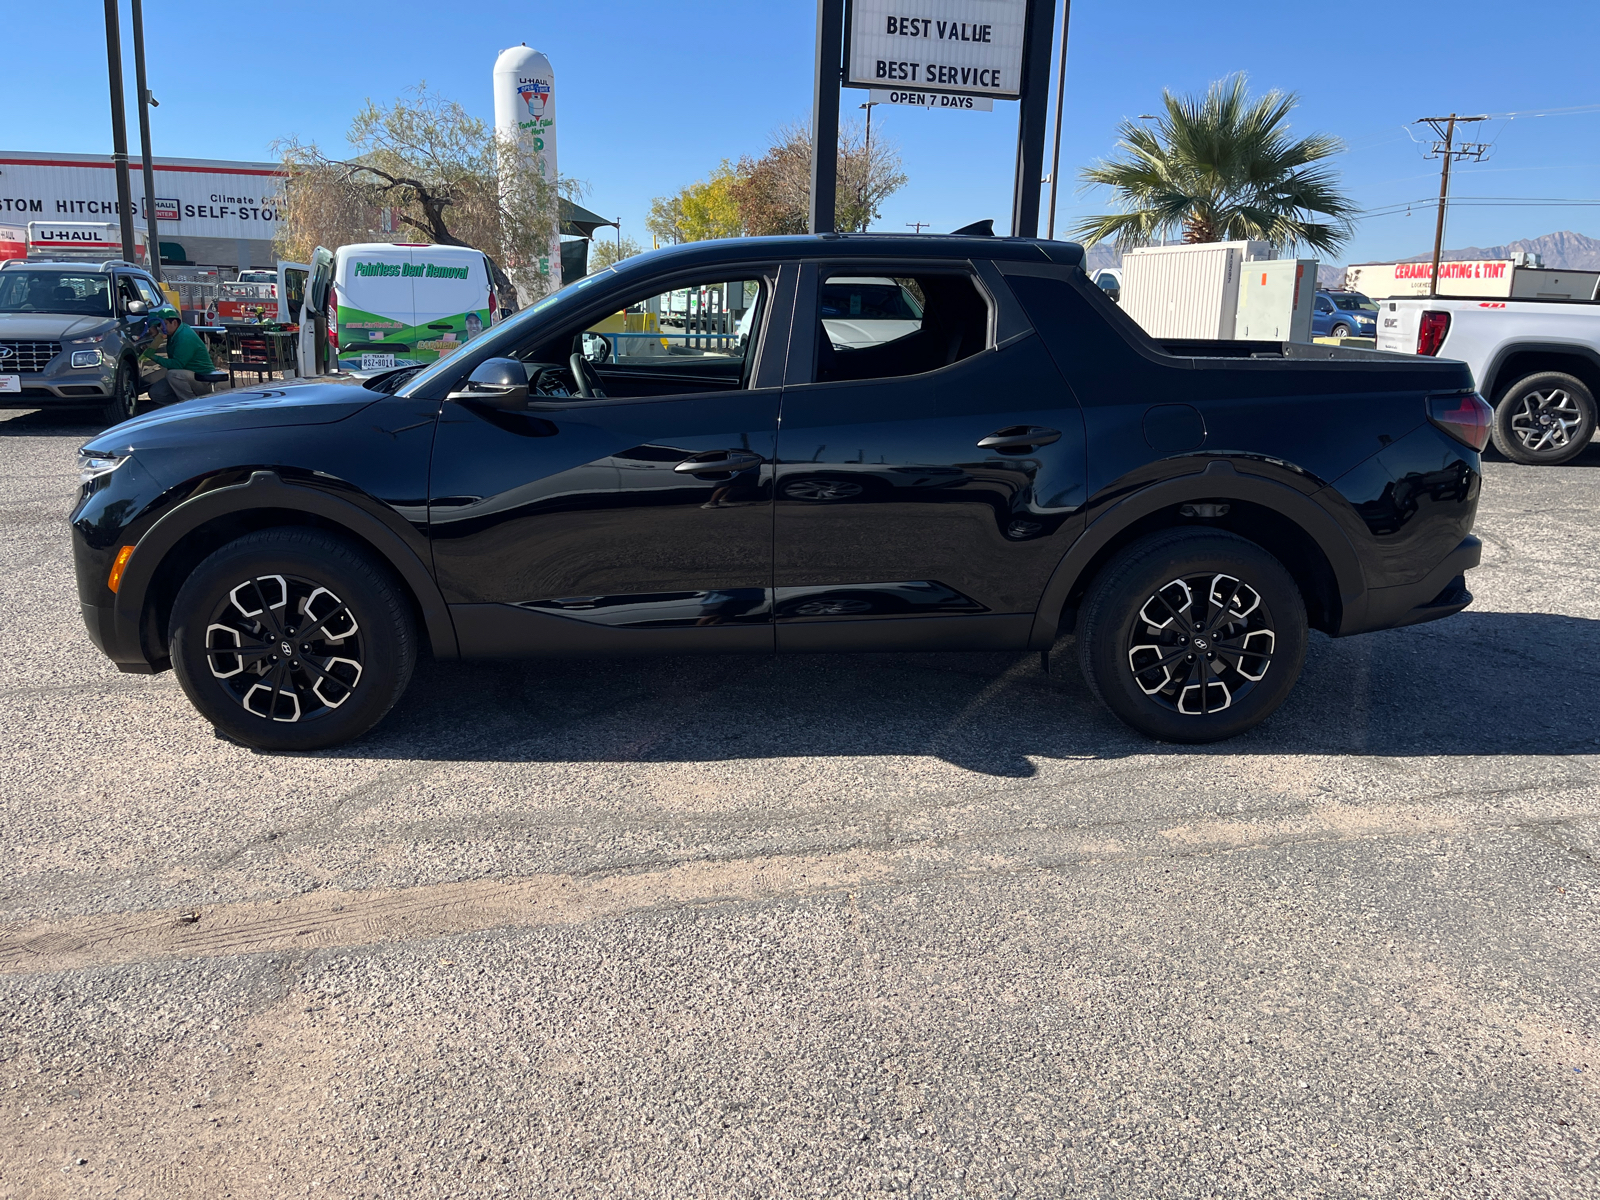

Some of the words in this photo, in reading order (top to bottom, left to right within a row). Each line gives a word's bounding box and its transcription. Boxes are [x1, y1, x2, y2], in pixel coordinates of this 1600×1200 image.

[886, 16, 931, 38] BEST
[936, 20, 991, 43] VALUE
[519, 77, 549, 86] U-HAUL
[876, 60, 919, 81] BEST
[926, 64, 1000, 87] SERVICE
[890, 91, 925, 105] OPEN
[929, 95, 937, 105] 7
[940, 96, 973, 109] DAYS
[210, 194, 254, 205] Climate
[41, 230, 102, 241] U-HAUL
[354, 262, 401, 277] Paintless
[401, 262, 426, 277] Dent
[425, 263, 469, 280] Removal
[1438, 263, 1472, 279] OATING
[1475, 264, 1480, 278] &
[1483, 263, 1506, 278] TINT
